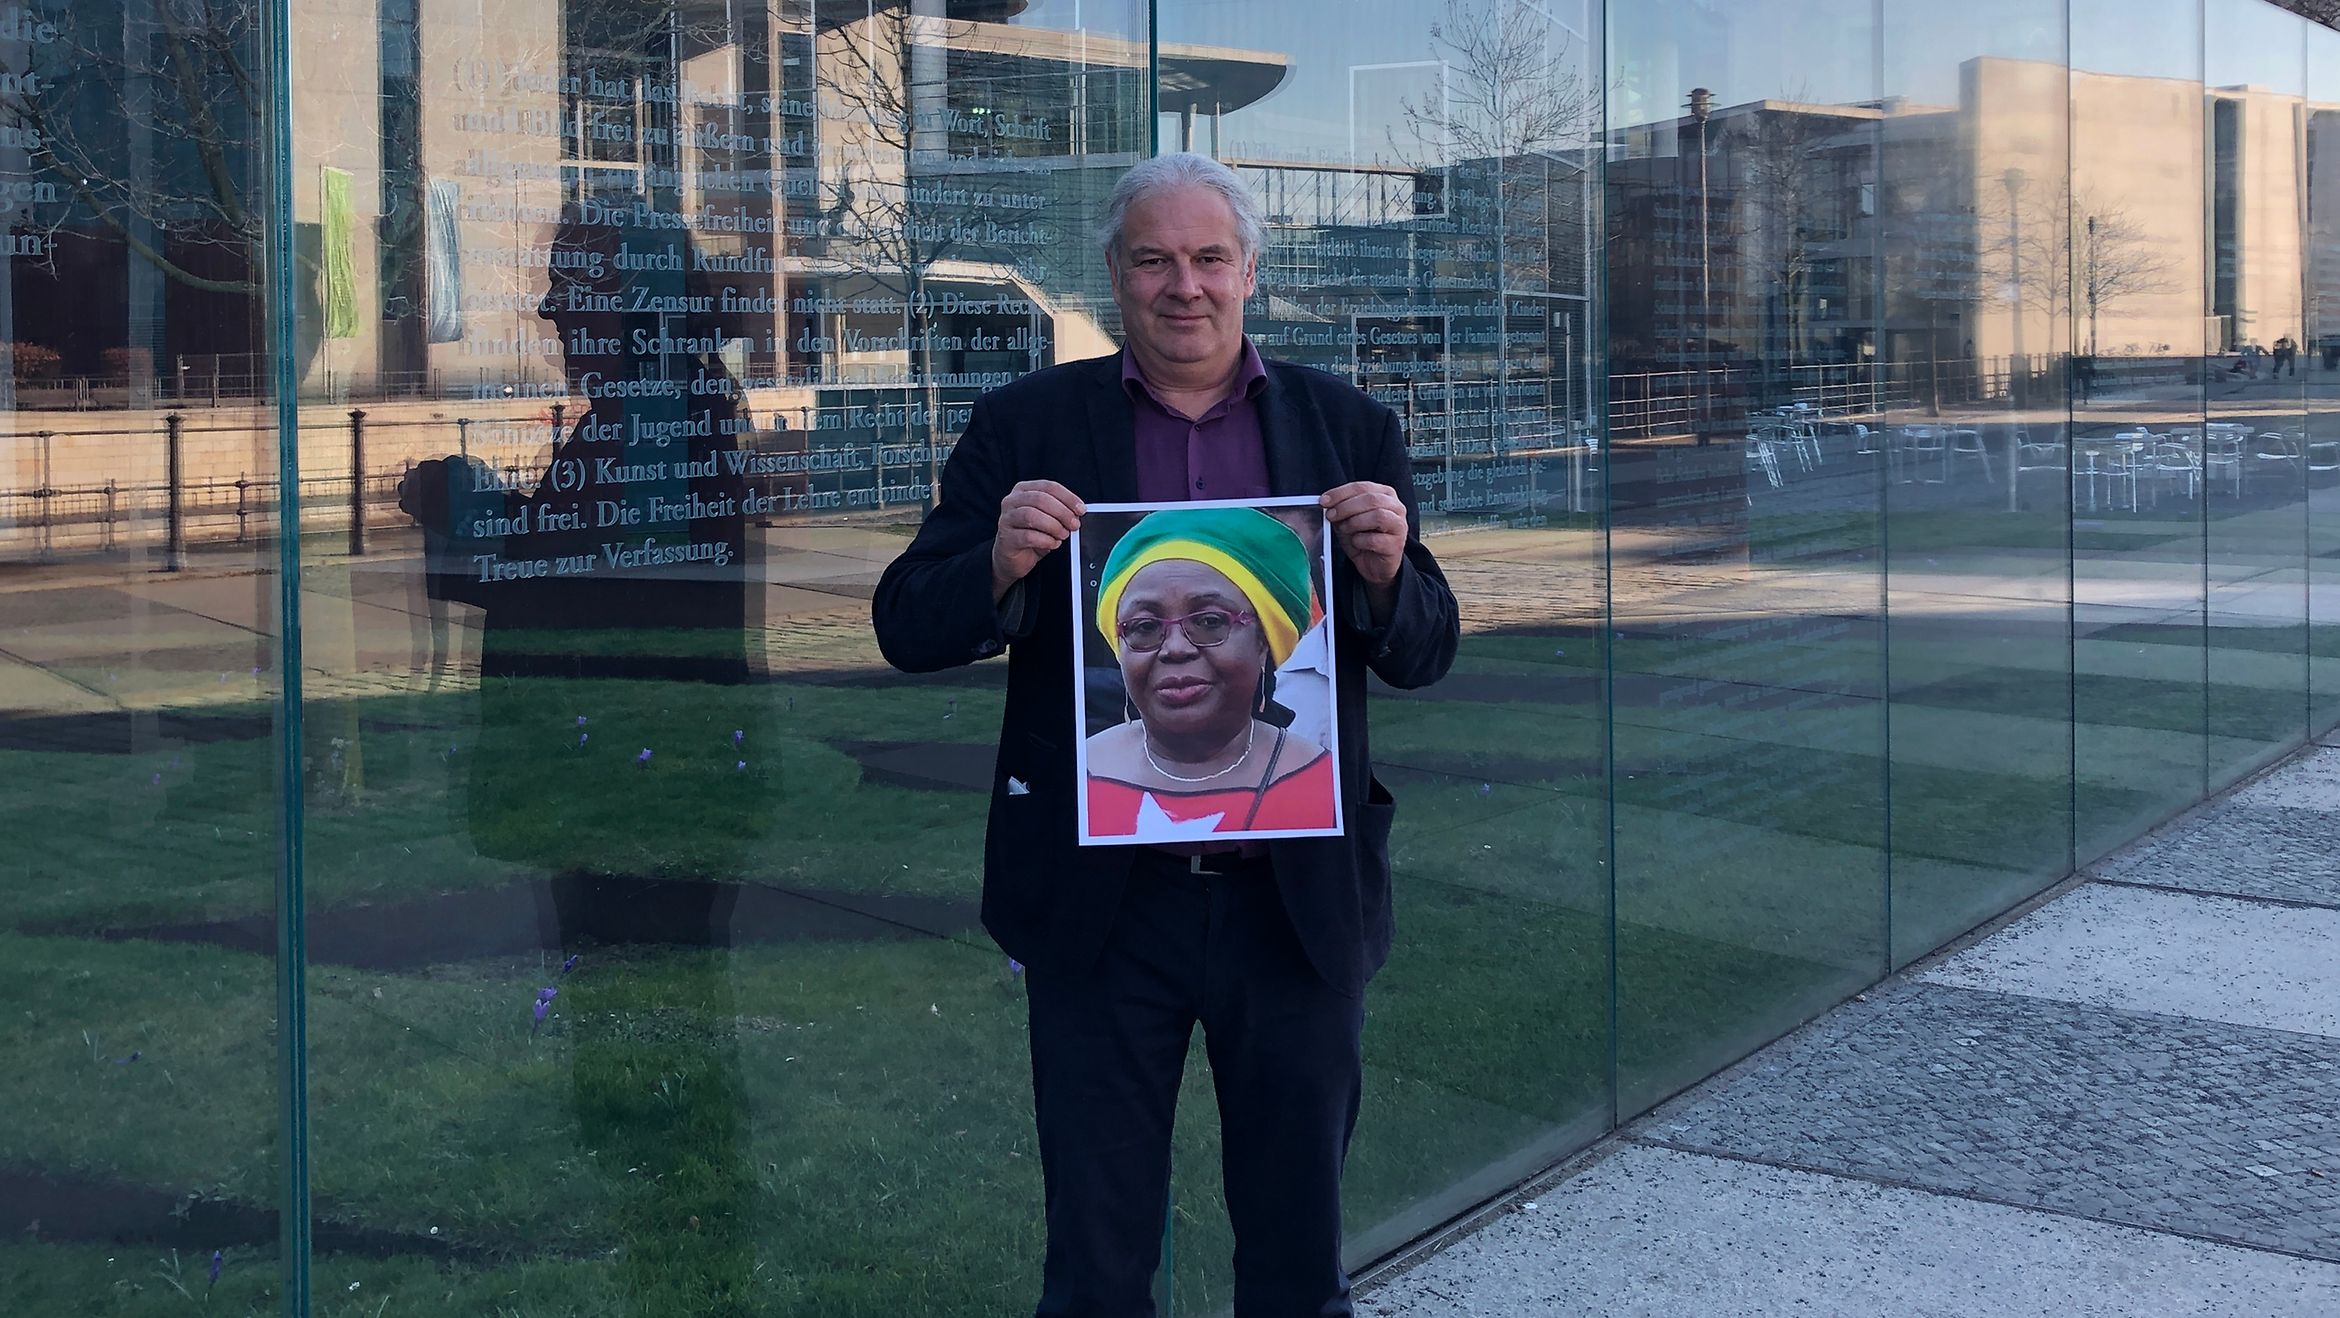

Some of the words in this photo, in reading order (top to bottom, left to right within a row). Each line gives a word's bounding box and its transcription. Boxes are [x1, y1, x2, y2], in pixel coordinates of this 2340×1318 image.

[0, 6, 55, 43] die
[586, 68, 631, 98] hat
[761, 90, 813, 118] seine
[937, 108, 989, 138] Wort,
[994, 113, 1052, 141] Schrift
[591, 111, 633, 143] frei
[642, 127, 667, 146] zu
[764, 130, 804, 157] und
[973, 187, 995, 207] zu
[580, 199, 625, 227] Die
[951, 217, 980, 242] der
[614, 242, 684, 271] durch
[1359, 239, 1392, 258] ihnen
[566, 284, 623, 313] Eine
[631, 285, 713, 314] Zensur
[793, 289, 848, 315] nicht
[851, 296, 902, 316] statt.
[909, 288, 934, 320] (2)
[941, 290, 992, 316] Diese
[1316, 296, 1337, 316] der
[1511, 300, 1546, 317] Kinder
[570, 327, 621, 356] ihre
[797, 326, 835, 354] den
[842, 323, 963, 353] Vorschriften
[970, 327, 1000, 352] der
[1006, 327, 1055, 358] allge-
[1268, 326, 1290, 346] auf
[1292, 326, 1334, 346] Grund
[1369, 326, 1418, 346] Gesetzes
[1421, 331, 1442, 345] von
[1445, 327, 1463, 345] er
[581, 371, 682, 400] Gesetze,
[692, 367, 734, 396] den
[1417, 382, 1465, 401] Grünen
[582, 413, 624, 443] der
[628, 409, 713, 448] Jugend
[850, 401, 907, 430] Recht
[551, 458, 586, 492] (3)
[594, 456, 668, 486] Kunst
[673, 451, 718, 480] und
[721, 441, 865, 476] Wissenschaft,
[1467, 463, 1485, 481] die
[472, 505, 531, 538] sind
[536, 502, 588, 533] frei.
[595, 499, 642, 529] Die
[647, 491, 737, 523] Freiheit
[741, 487, 778, 516] der
[782, 482, 842, 512] Lehre
[1438, 488, 1484, 512] selische
[473, 553, 549, 584] Treue
[555, 555, 597, 576] zur
[601, 537, 735, 569] Verfassung.
